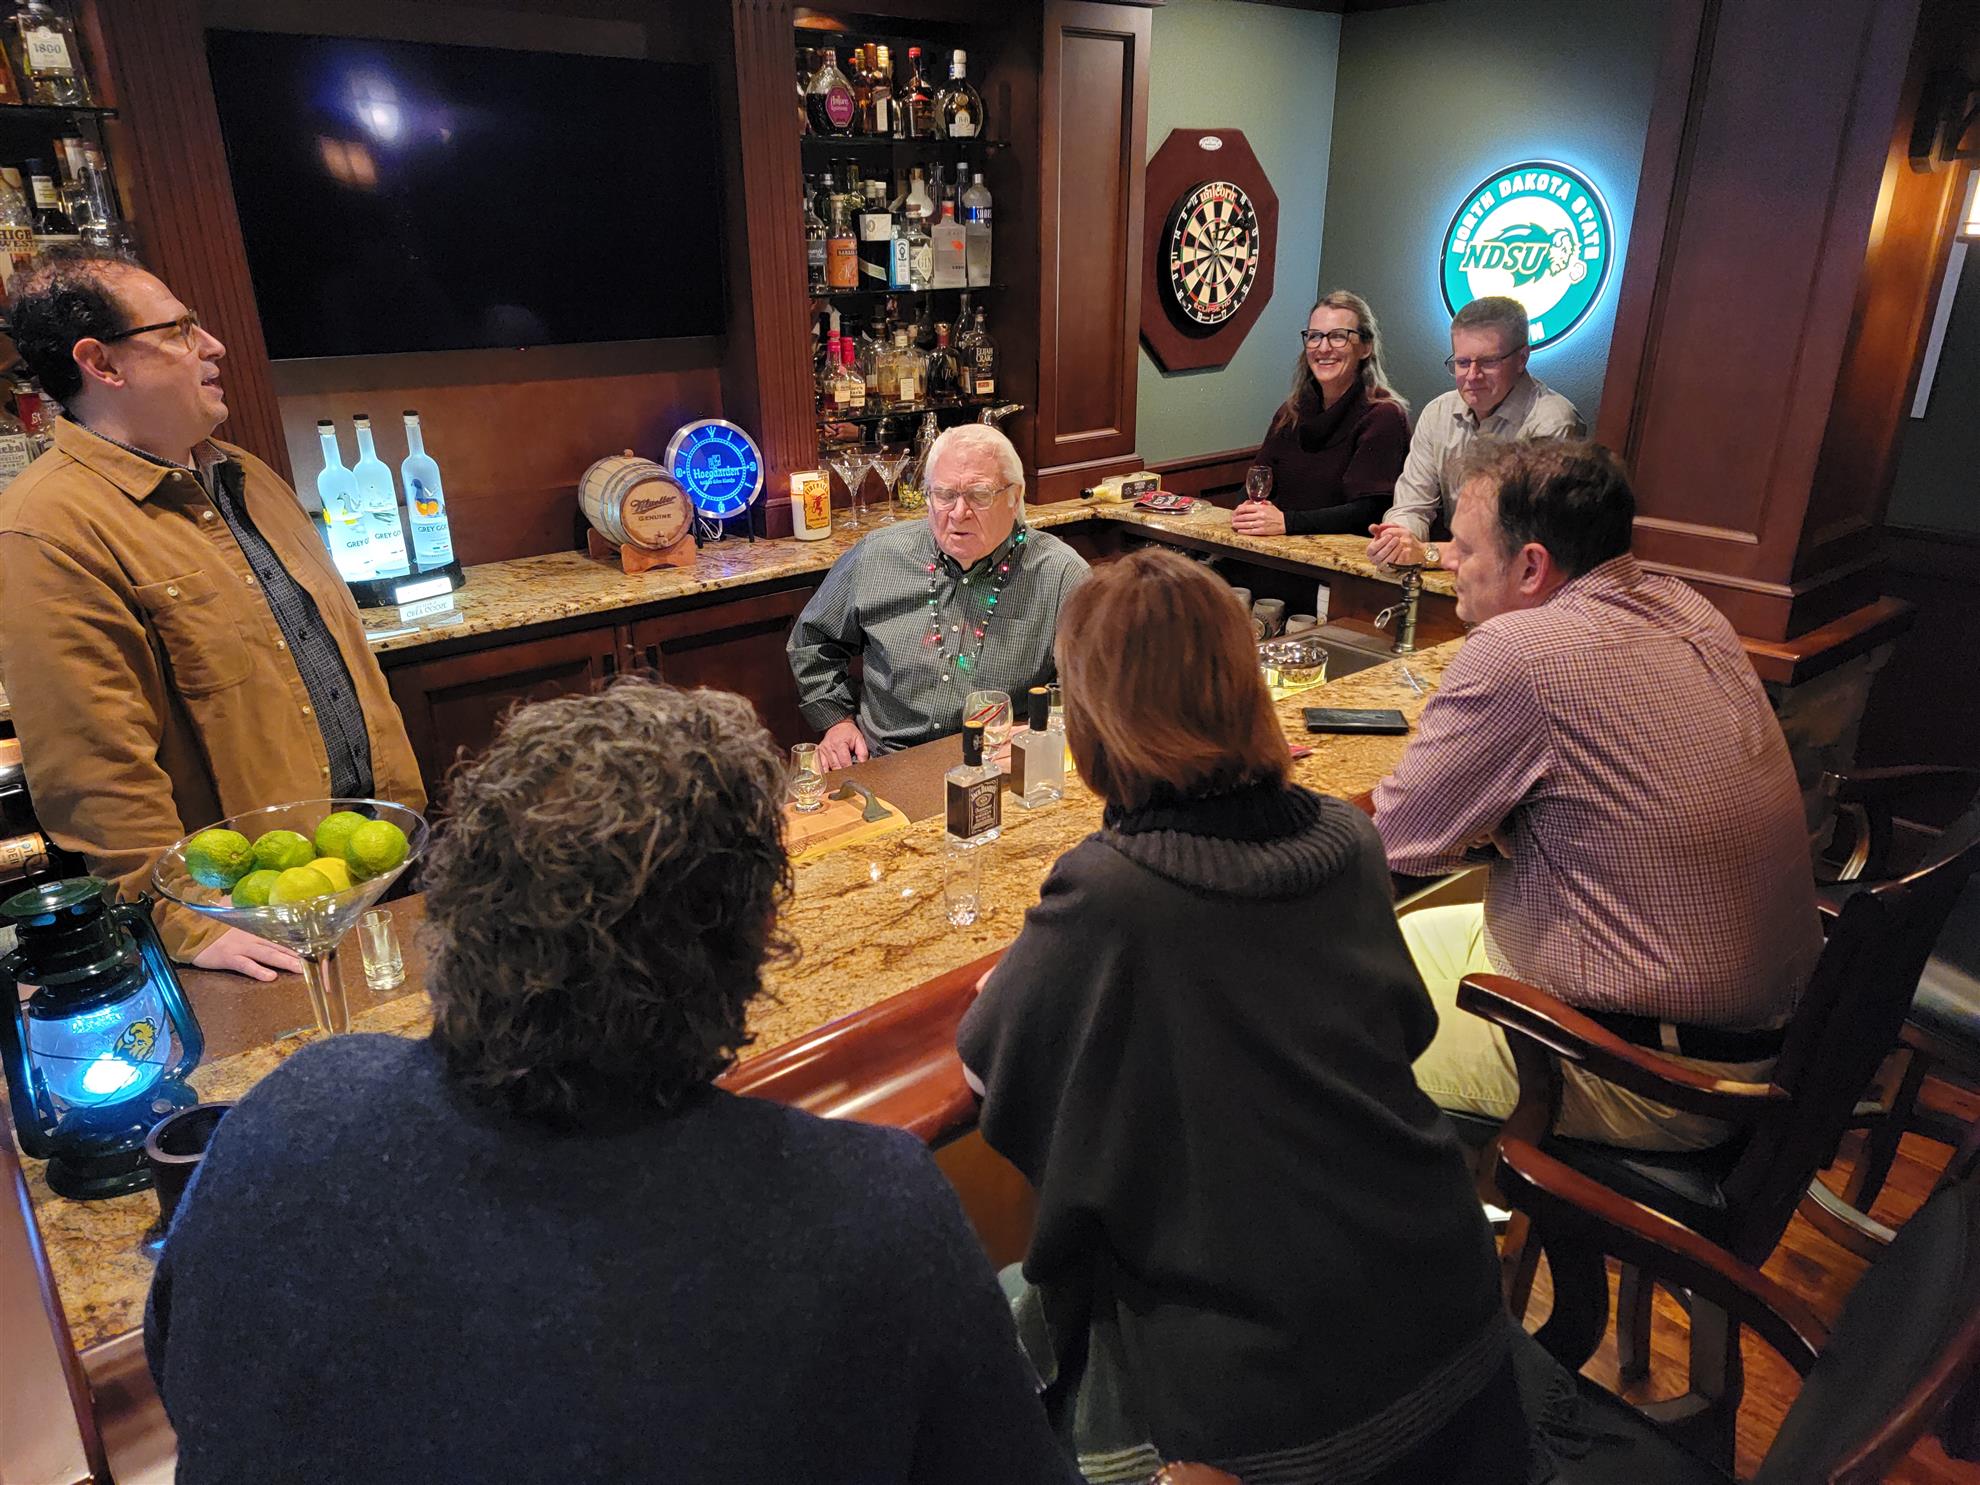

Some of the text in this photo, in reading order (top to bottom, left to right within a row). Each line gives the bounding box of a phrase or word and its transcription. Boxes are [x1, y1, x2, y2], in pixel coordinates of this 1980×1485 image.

[32, 42, 61, 54] 1800
[1452, 173, 1600, 260] NORTH DAKOTA STATE
[1461, 243, 1550, 272] NDSU
[976, 354, 993, 362] CRAIG
[418, 525, 435, 533] GREY
[374, 531, 392, 540] GREY
[346, 539, 364, 549] GREY
